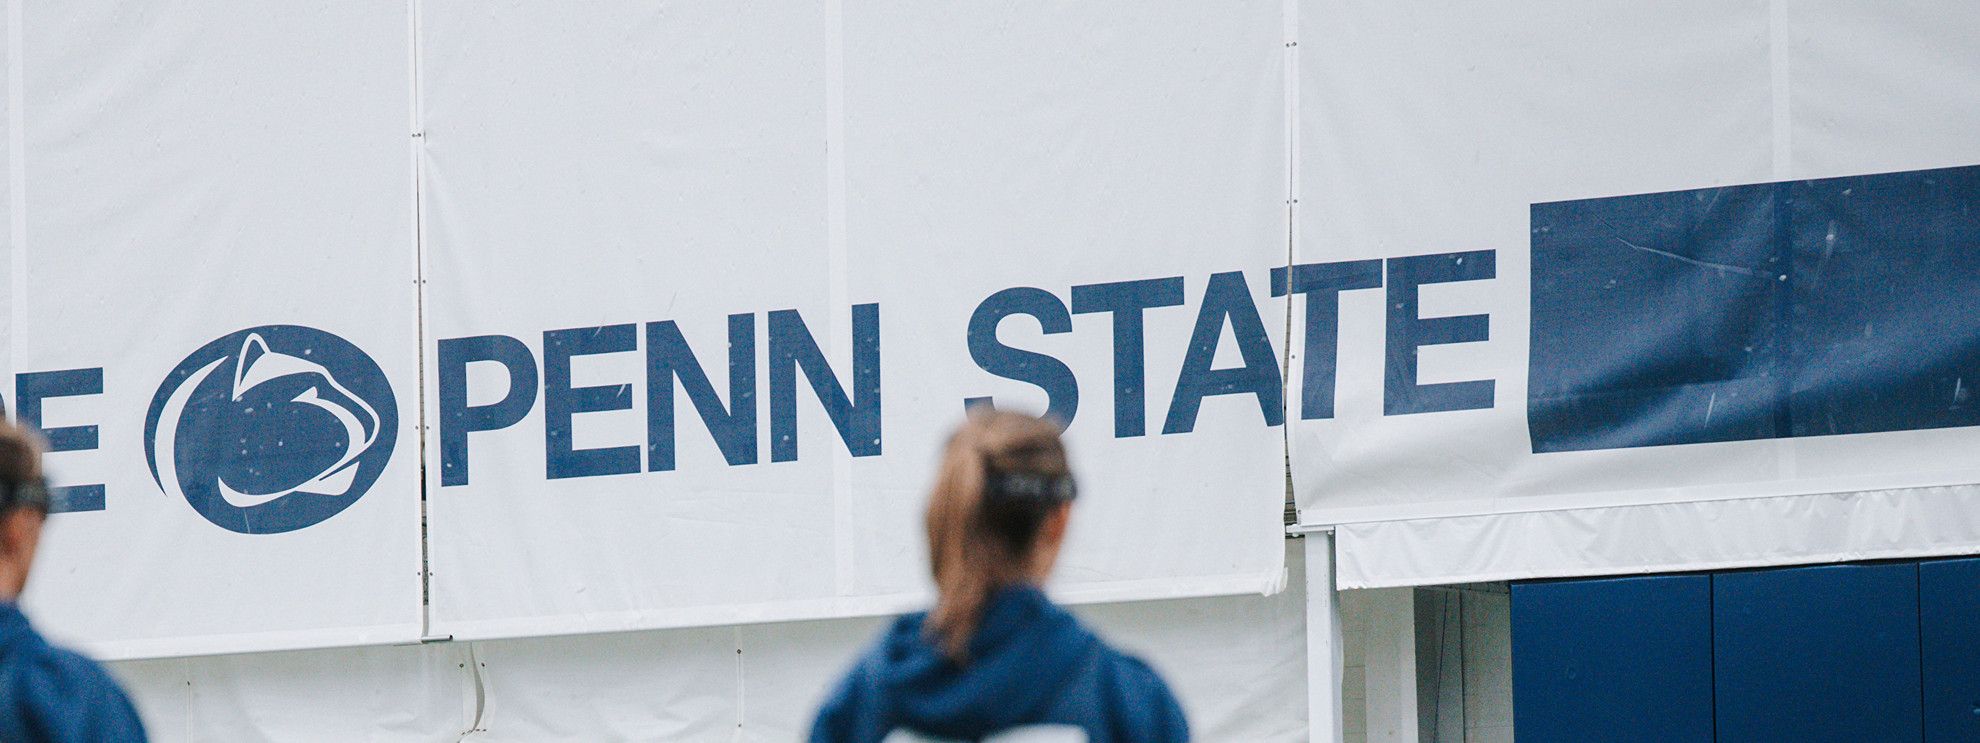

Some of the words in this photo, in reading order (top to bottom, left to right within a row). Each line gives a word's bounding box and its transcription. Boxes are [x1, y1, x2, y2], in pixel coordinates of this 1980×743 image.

[0, 367, 106, 514] E
[438, 303, 882, 487] PENN
[964, 249, 1497, 439] STATE
